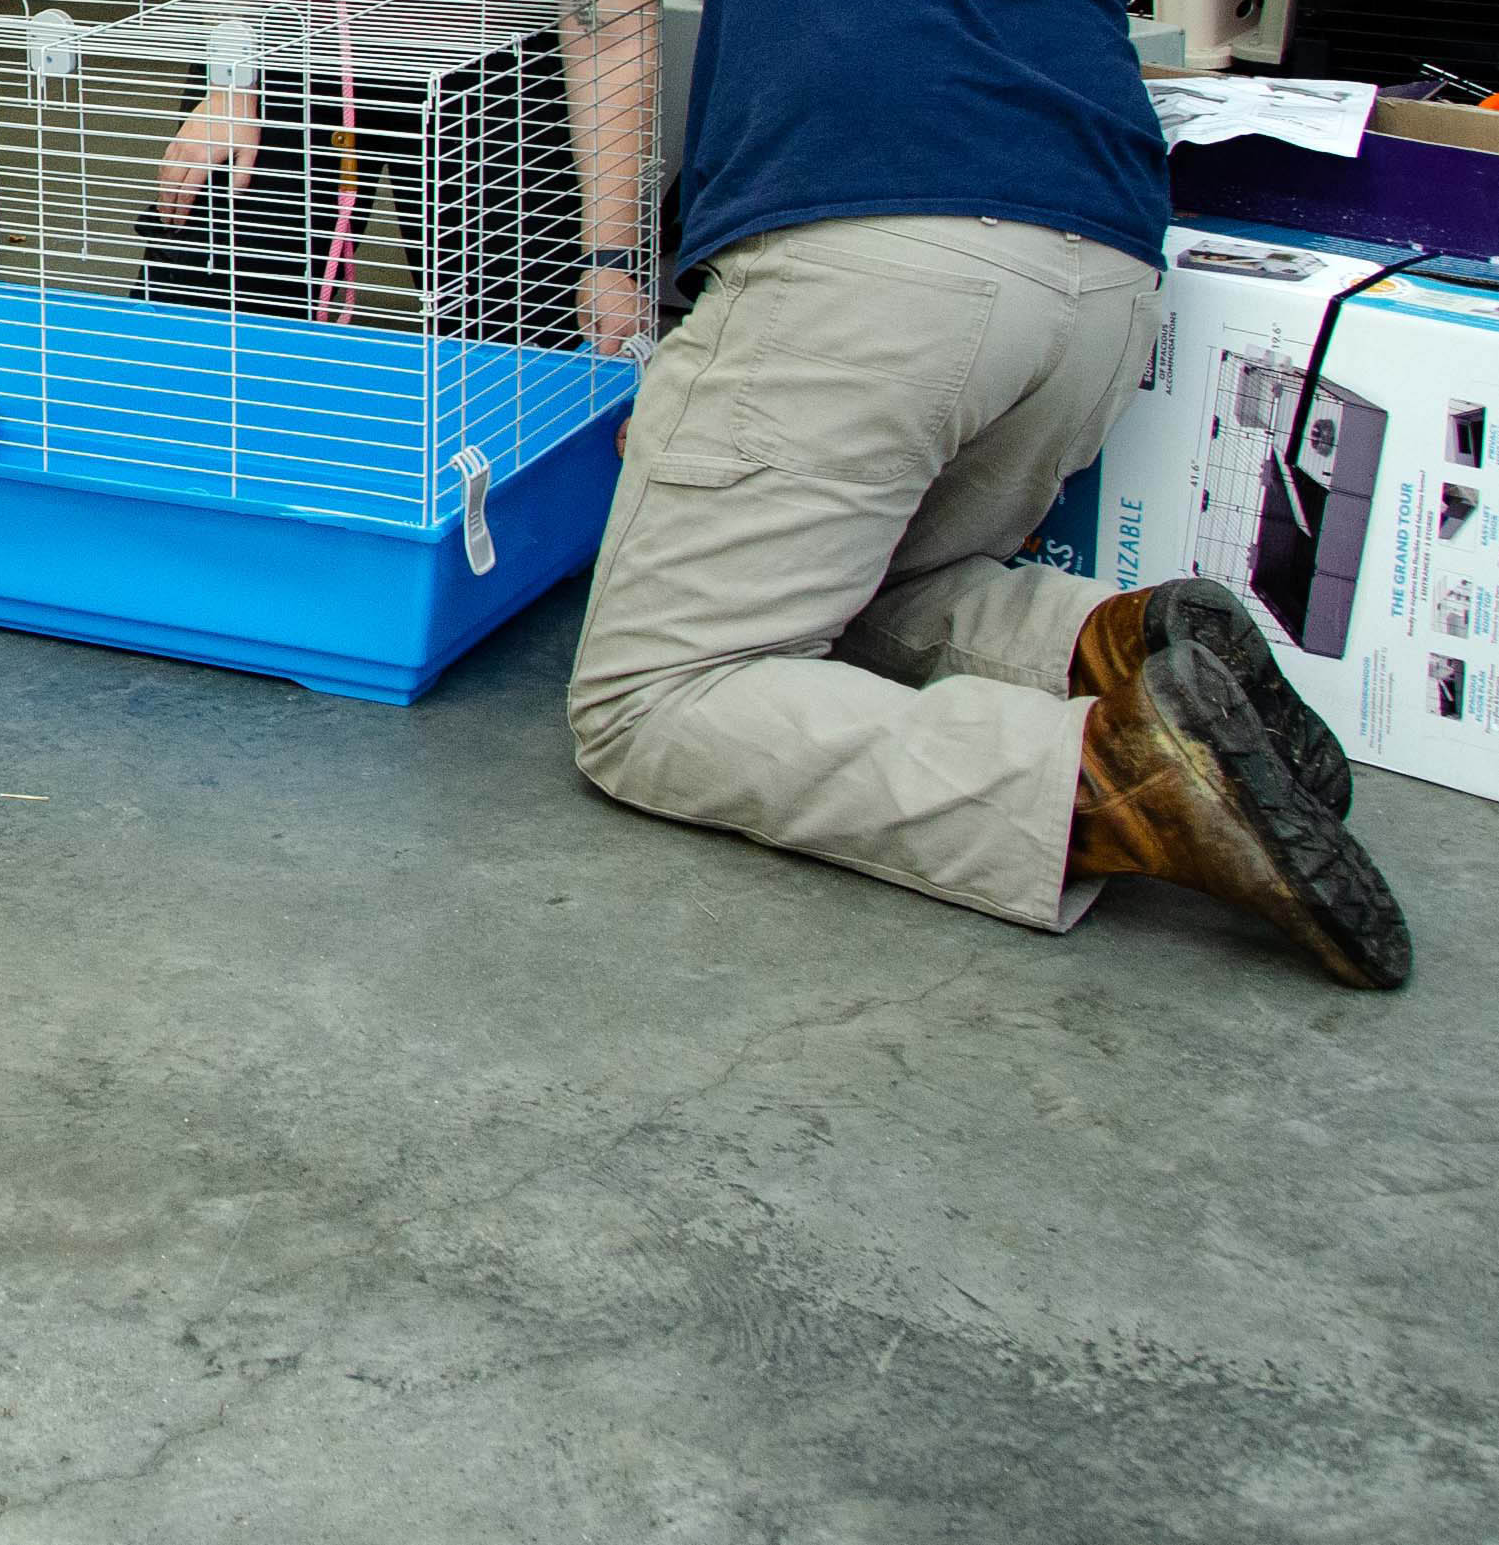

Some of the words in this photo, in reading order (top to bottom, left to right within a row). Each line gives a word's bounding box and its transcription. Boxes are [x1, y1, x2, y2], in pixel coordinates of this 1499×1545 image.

[1160, 323, 1169, 367] SPACIOUS
[1165, 311, 1177, 396] ACCOMMODATIONS
[1159, 368, 1166, 380] OF
[1398, 482, 1414, 526] TOUR
[1393, 529, 1409, 585] GRAND
[1390, 588, 1405, 616] THE
